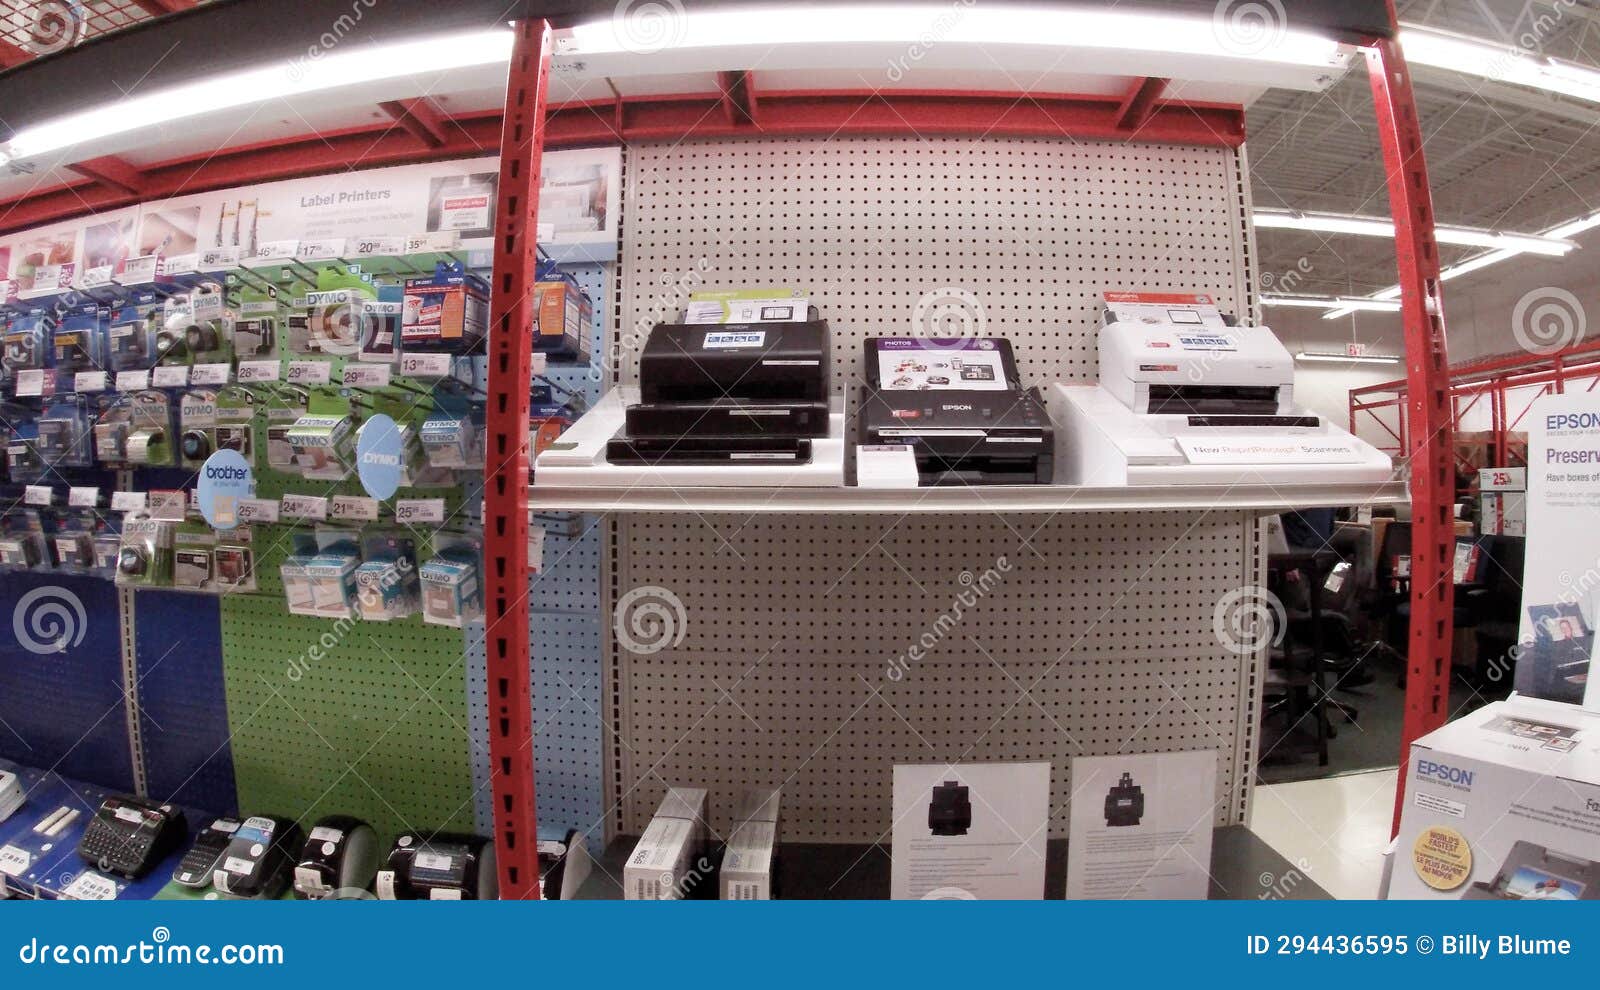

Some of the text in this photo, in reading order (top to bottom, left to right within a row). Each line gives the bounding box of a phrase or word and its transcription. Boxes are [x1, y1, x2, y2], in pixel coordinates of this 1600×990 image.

[300, 189, 391, 208] Label Printers
[307, 292, 348, 305] DYMO
[364, 304, 394, 313] DYMO
[184, 405, 213, 415] DYMO
[1546, 412, 1600, 430] EPSON
[289, 434, 328, 446] DYMO
[363, 452, 399, 466] DYMO
[206, 465, 248, 480] brother
[1546, 473, 1566, 482] Have
[1567, 473, 1590, 482] boxes
[1416, 759, 1473, 786] EPSON
[1429, 838, 1459, 853] FASTEST
[1424, 857, 1438, 869] PLUS
